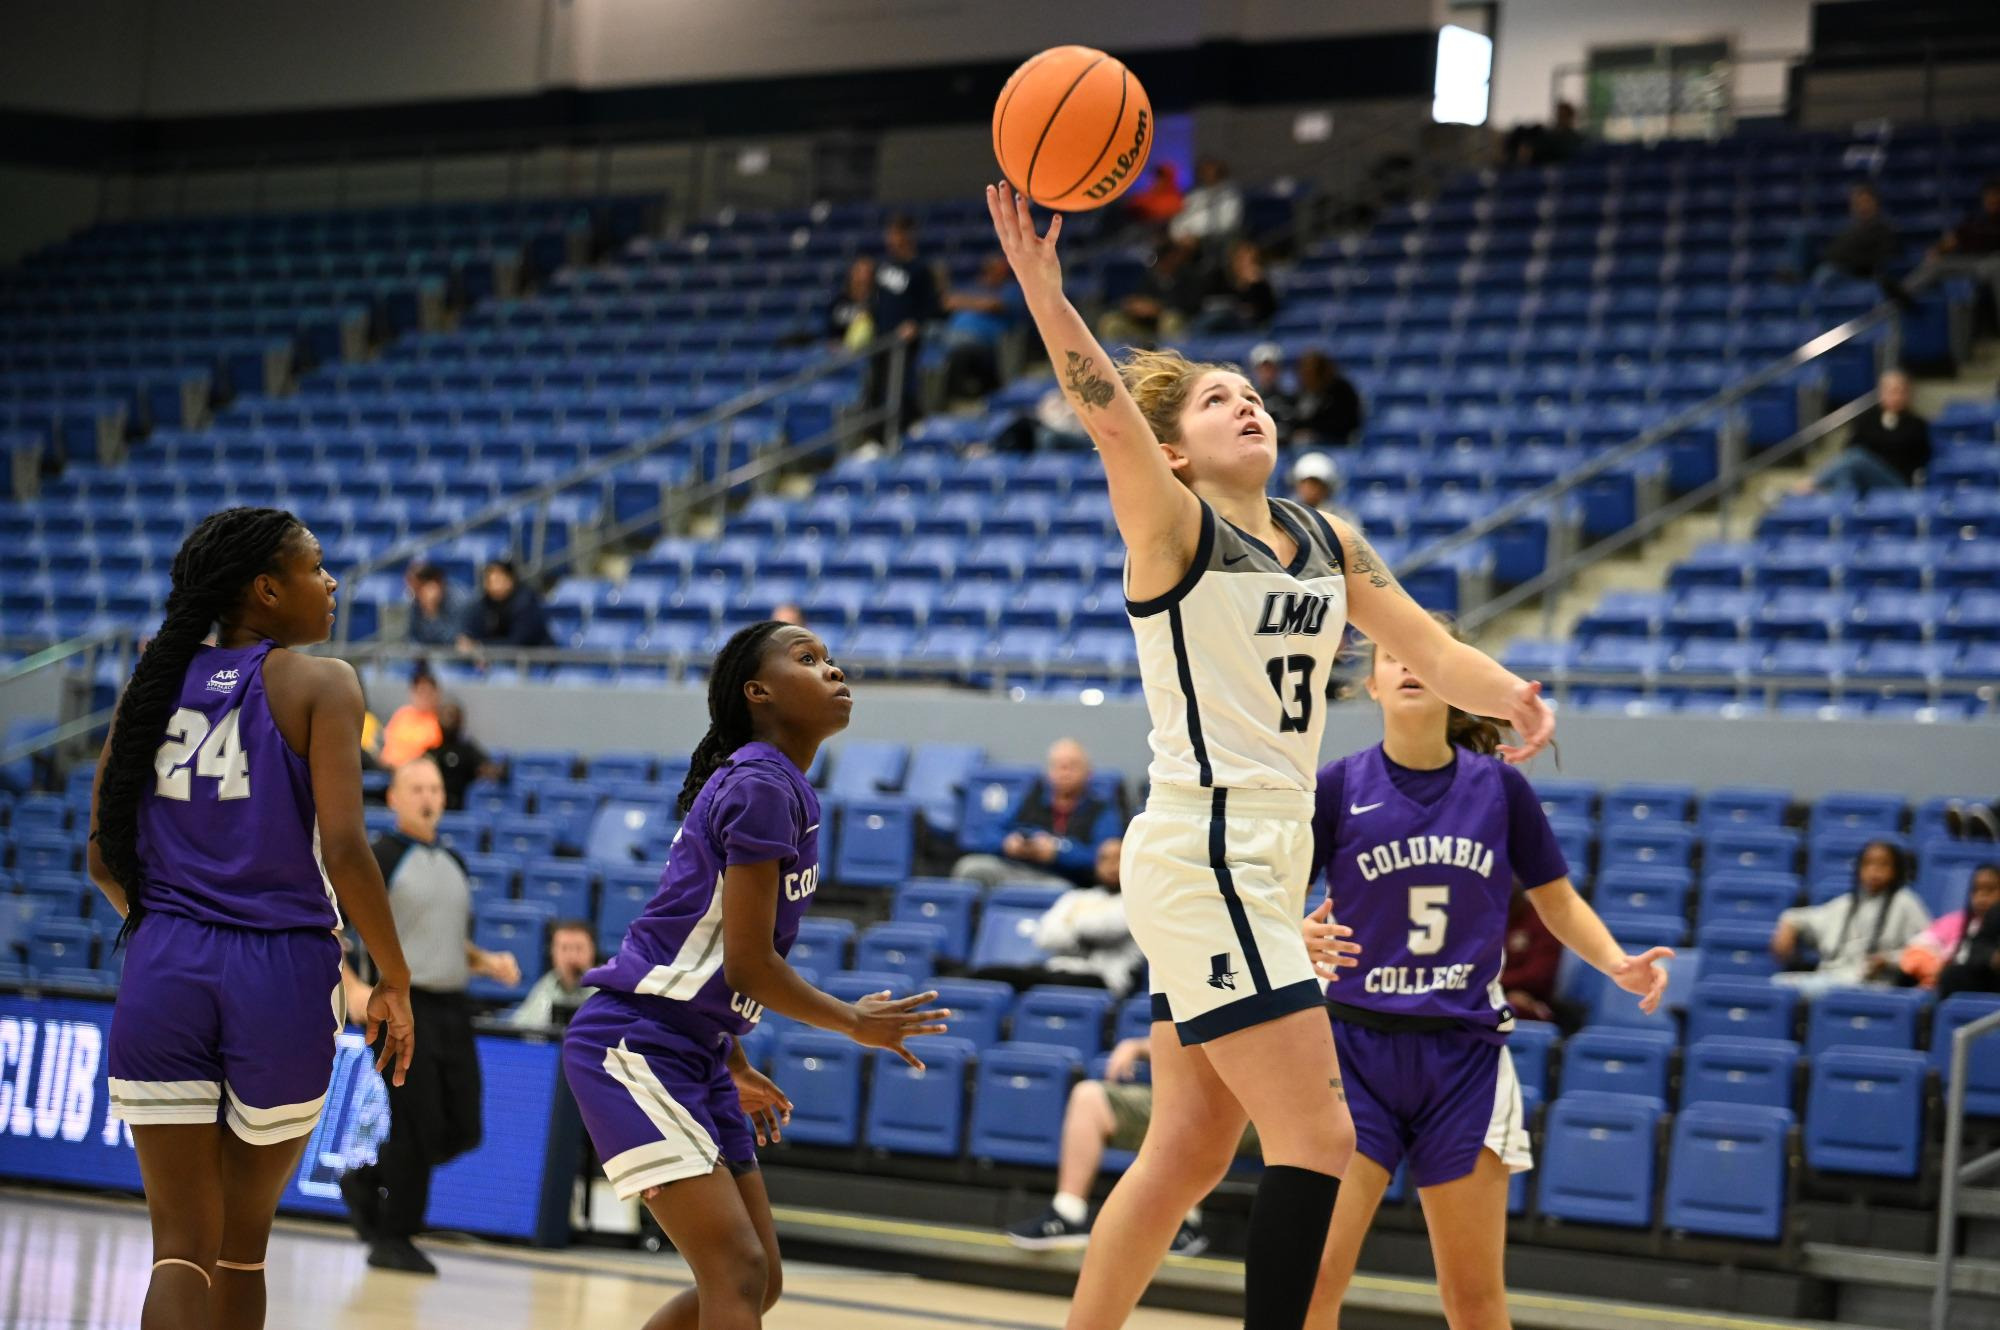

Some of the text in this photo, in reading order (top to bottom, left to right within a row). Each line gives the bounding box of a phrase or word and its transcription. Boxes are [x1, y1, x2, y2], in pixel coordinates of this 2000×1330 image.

[1083, 108, 1148, 200] Wilson
[1254, 591, 1334, 637] LMU
[1266, 653, 1317, 733] 13
[154, 706, 251, 802] 24
[1356, 835, 1494, 881] COLUMBIA
[1407, 884, 1450, 956] 5
[1364, 963, 1475, 995] COLLEGE
[0, 1014, 102, 1143] CLUB
